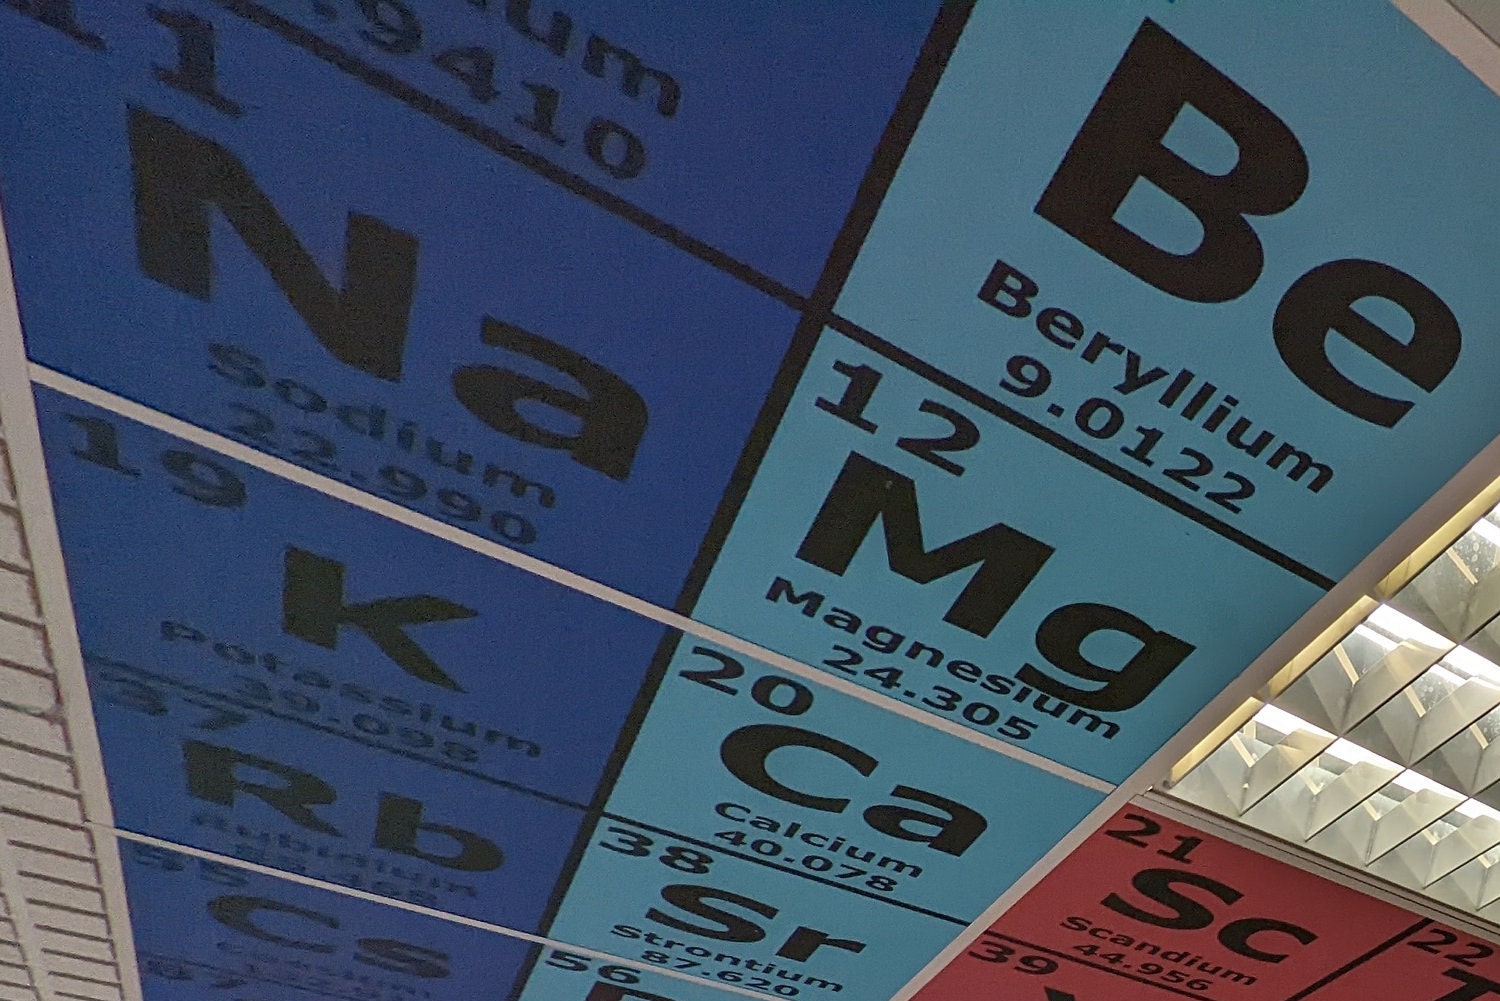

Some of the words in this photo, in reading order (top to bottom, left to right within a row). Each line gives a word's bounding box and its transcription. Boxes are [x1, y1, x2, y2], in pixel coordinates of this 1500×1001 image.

[1033, 17, 1463, 430] Be
[126, 102, 649, 482] Na
[207, 342, 556, 507] Sodium
[814, 359, 982, 477] 12
[976, 259, 1335, 494] Beryllium
[64, 412, 247, 508] 19
[230, 402, 538, 545] 22.990
[1000, 355, 1256, 515] 9.0122
[282, 545, 480, 694] K
[793, 450, 1196, 713] Mg
[677, 645, 815, 717] 20
[764, 576, 1122, 741] Magnesium
[823, 644, 1041, 742] 24.305
[181, 740, 504, 872] Rb
[719, 723, 988, 857] Ca
[598, 826, 715, 876] 38
[713, 801, 924, 880] Calcium
[714, 827, 898, 894] 40.078
[1104, 813, 1206, 864] 21
[208, 894, 450, 979] Cs
[609, 923, 844, 993] Strontium
[644, 883, 867, 963] Sr
[968, 940, 1059, 977] 39
[1059, 916, 1258, 987] Scandium
[1100, 867, 1319, 964] Sc
[1407, 928, 1496, 968] 22
[545, 949, 641, 985] 56
[641, 950, 800, 997] 87.620
[1073, 944, 1213, 992] 44.956
